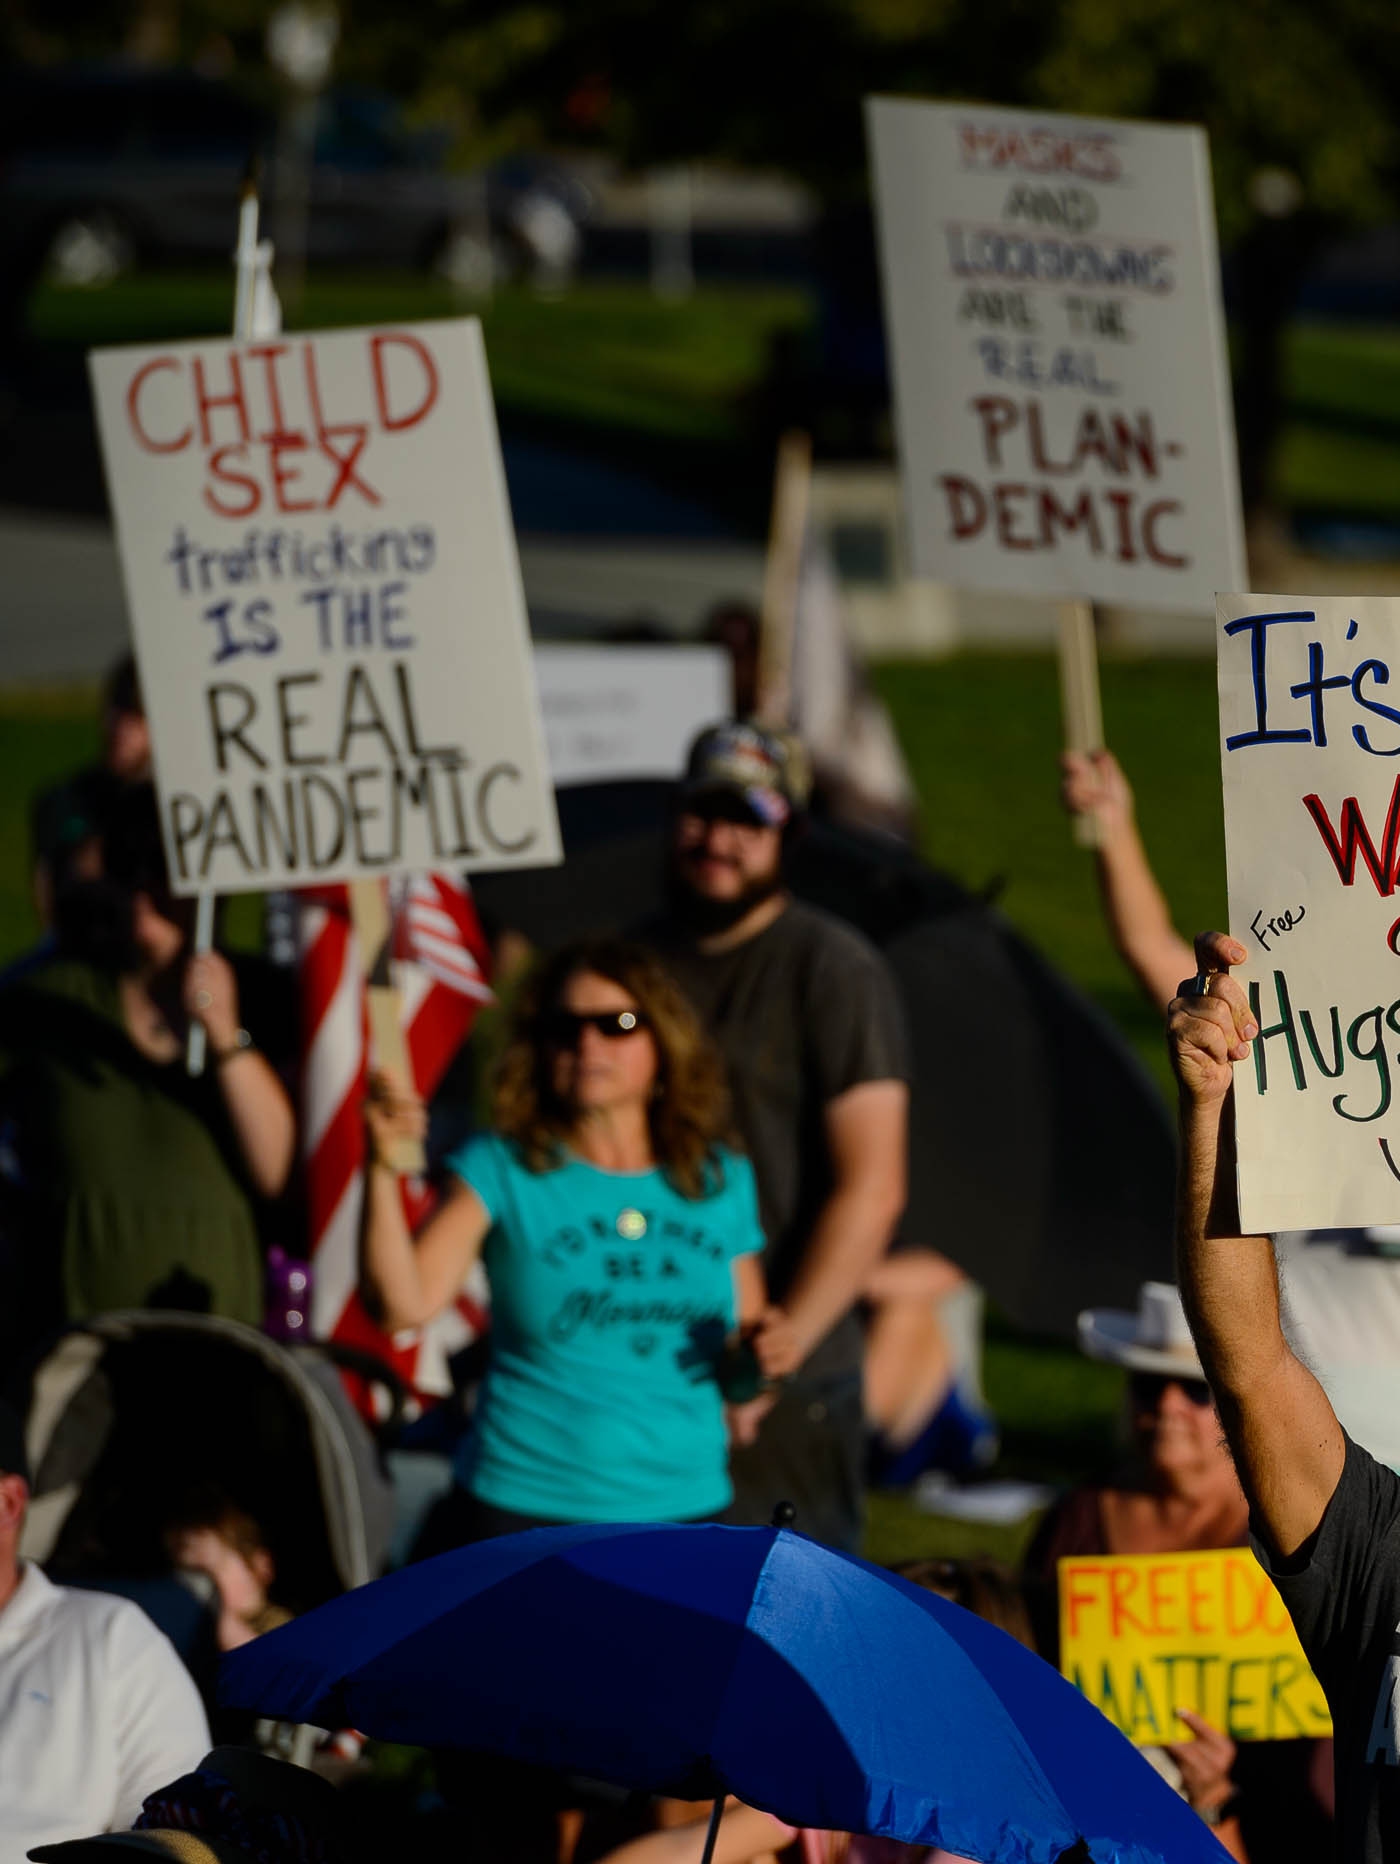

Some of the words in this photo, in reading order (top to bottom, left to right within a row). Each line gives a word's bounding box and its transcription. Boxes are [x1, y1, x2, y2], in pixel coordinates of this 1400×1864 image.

[1008, 185, 1098, 234] AND
[127, 332, 440, 455] CHILD
[976, 336, 1119, 395] REAL
[204, 431, 382, 518] SEX
[972, 396, 1183, 480] PLAN-
[168, 525, 437, 595] trafficking
[938, 473, 1191, 571] DEMIC
[205, 601, 282, 664] IS
[304, 583, 416, 652] THE
[206, 662, 467, 774] REAL
[170, 763, 537, 880] PANDEMIC
[1251, 905, 1305, 951] Free
[1067, 1557, 1291, 1639] FREEDO
